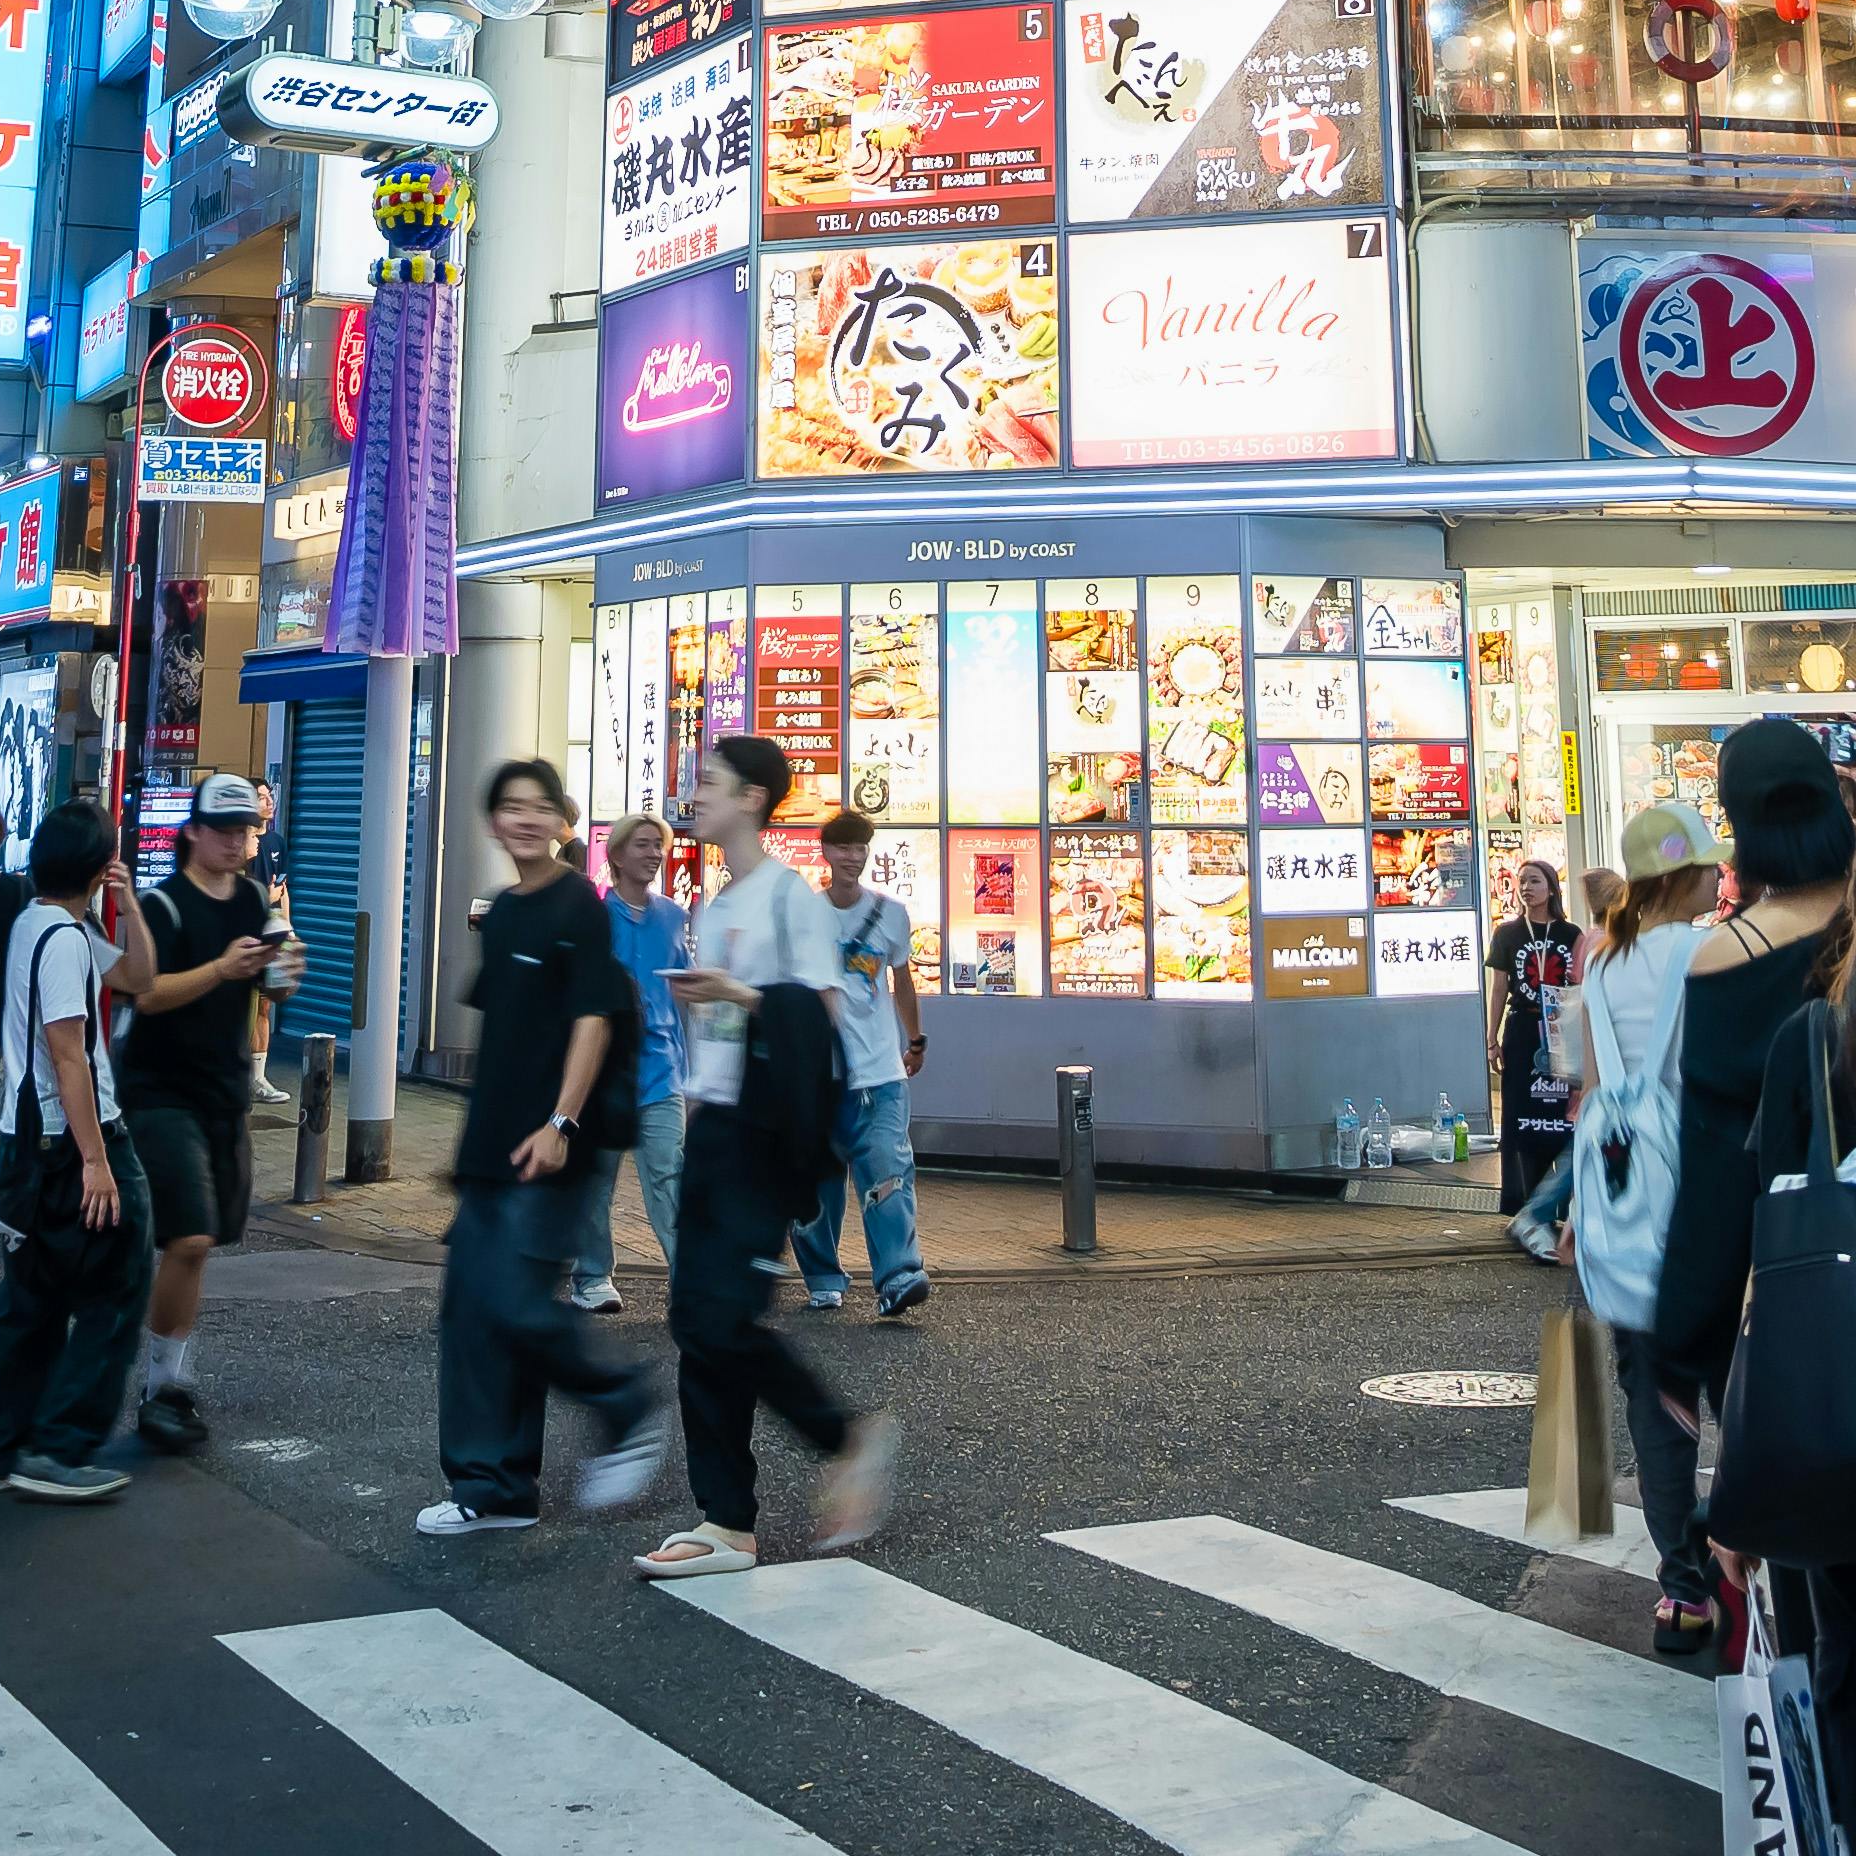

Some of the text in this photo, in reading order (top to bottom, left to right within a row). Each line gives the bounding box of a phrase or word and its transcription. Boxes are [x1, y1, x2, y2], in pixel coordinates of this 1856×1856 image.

[1025, 9, 1043, 40] 5
[631, 18, 688, 68] 炭火居酒屋
[1243, 45, 1373, 75] 焼肉食べ放題
[638, 60, 731, 123] 浜焼 活貝 寿司
[931, 75, 1041, 97] SAKURA GARDEN
[1267, 70, 1347, 87] All you can eat
[263, 75, 491, 128] 渋谷センター街
[873, 70, 1045, 131] 桜ガーデン
[612, 95, 753, 216] 磯丸水産
[1250, 88, 1357, 201] 牛丸
[911, 150, 1035, 171] 個室あり 団体/貸切OK
[1196, 157, 1237, 175] GYU
[894, 167, 1046, 190] 女子会 飲み放題 食べ放題
[1196, 170, 1256, 189] MARU
[816, 204, 1000, 232] TEL 050-5285-6479
[634, 223, 719, 278] 24時間営業
[1025, 244, 1048, 276] 4
[82, 297, 127, 354] カラオケ館
[1101, 274, 1341, 351] Vanilla
[179, 350, 238, 363] FIRE HYDRANT
[849, 267, 972, 454] たくみ
[172, 365, 245, 402] 消火栓
[1178, 357, 1280, 386] バニラ
[176, 440, 263, 471] セキネ
[1120, 434, 1345, 461] TEL.03-5456-0826
[145, 482, 169, 493] 買取
[165, 469, 253, 483] 03-3464-2061
[1009, 544, 1028, 560] by
[1029, 542, 1077, 558] COAST
[683, 558, 705, 574] COAST
[792, 590, 804, 612] 5
[888, 588, 903, 610] 6
[985, 584, 1000, 607] 7
[1085, 583, 1099, 606] 8
[1185, 584, 1202, 607] 9
[1366, 604, 1442, 651] 金ちゃん
[758, 626, 841, 660] 桜ガーデン
[1260, 679, 1302, 698] よいしょ
[641, 681, 657, 813] 磯丸水産
[1053, 833, 1140, 853] 焼肉食べ放題
[1265, 853, 1359, 880] 磯丸水産
[1271, 947, 1359, 968] MALCOLM
[1380, 935, 1472, 965] 磯丸水産
[1515, 939, 1555, 980] RED HOT
[1530, 1075, 1569, 1094] Asahi
[1517, 1117, 1577, 1132] アサヒビー
